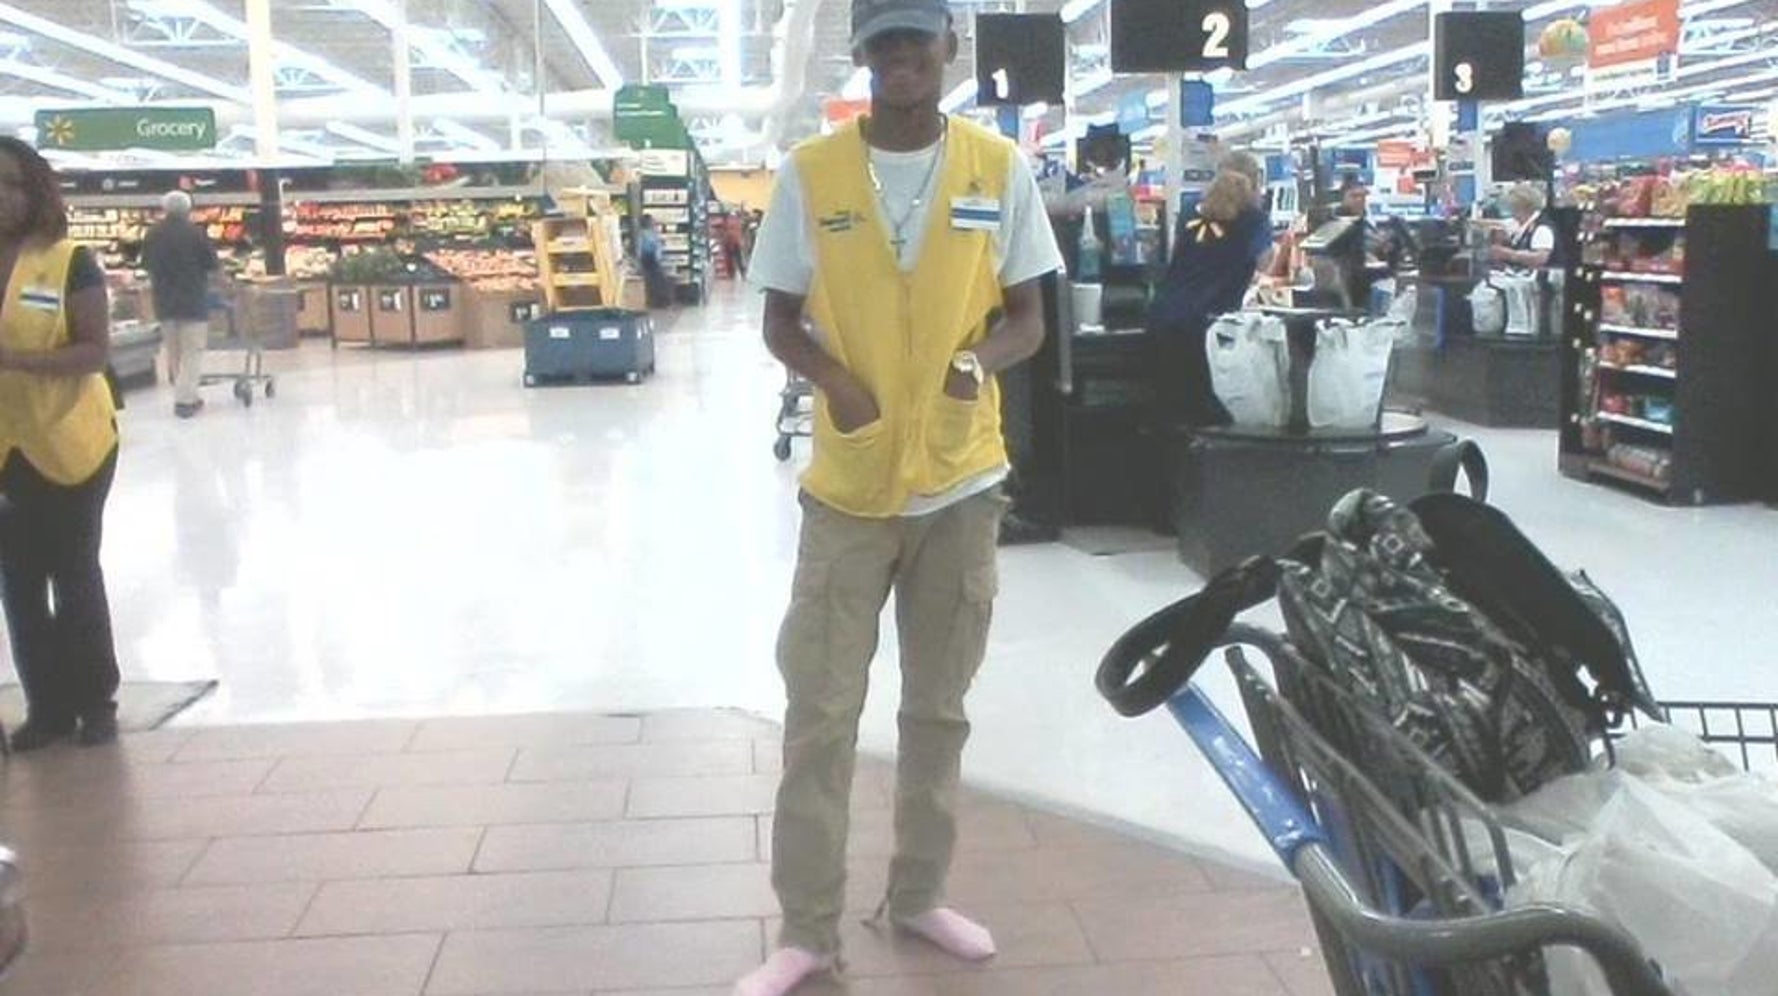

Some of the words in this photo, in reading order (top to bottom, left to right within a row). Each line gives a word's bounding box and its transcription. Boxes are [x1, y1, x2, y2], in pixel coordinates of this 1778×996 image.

[1201, 12, 1229, 57] 2
[992, 68, 1008, 99] 1
[1454, 63, 1472, 93] 3
[136, 118, 206, 140] Grocery
